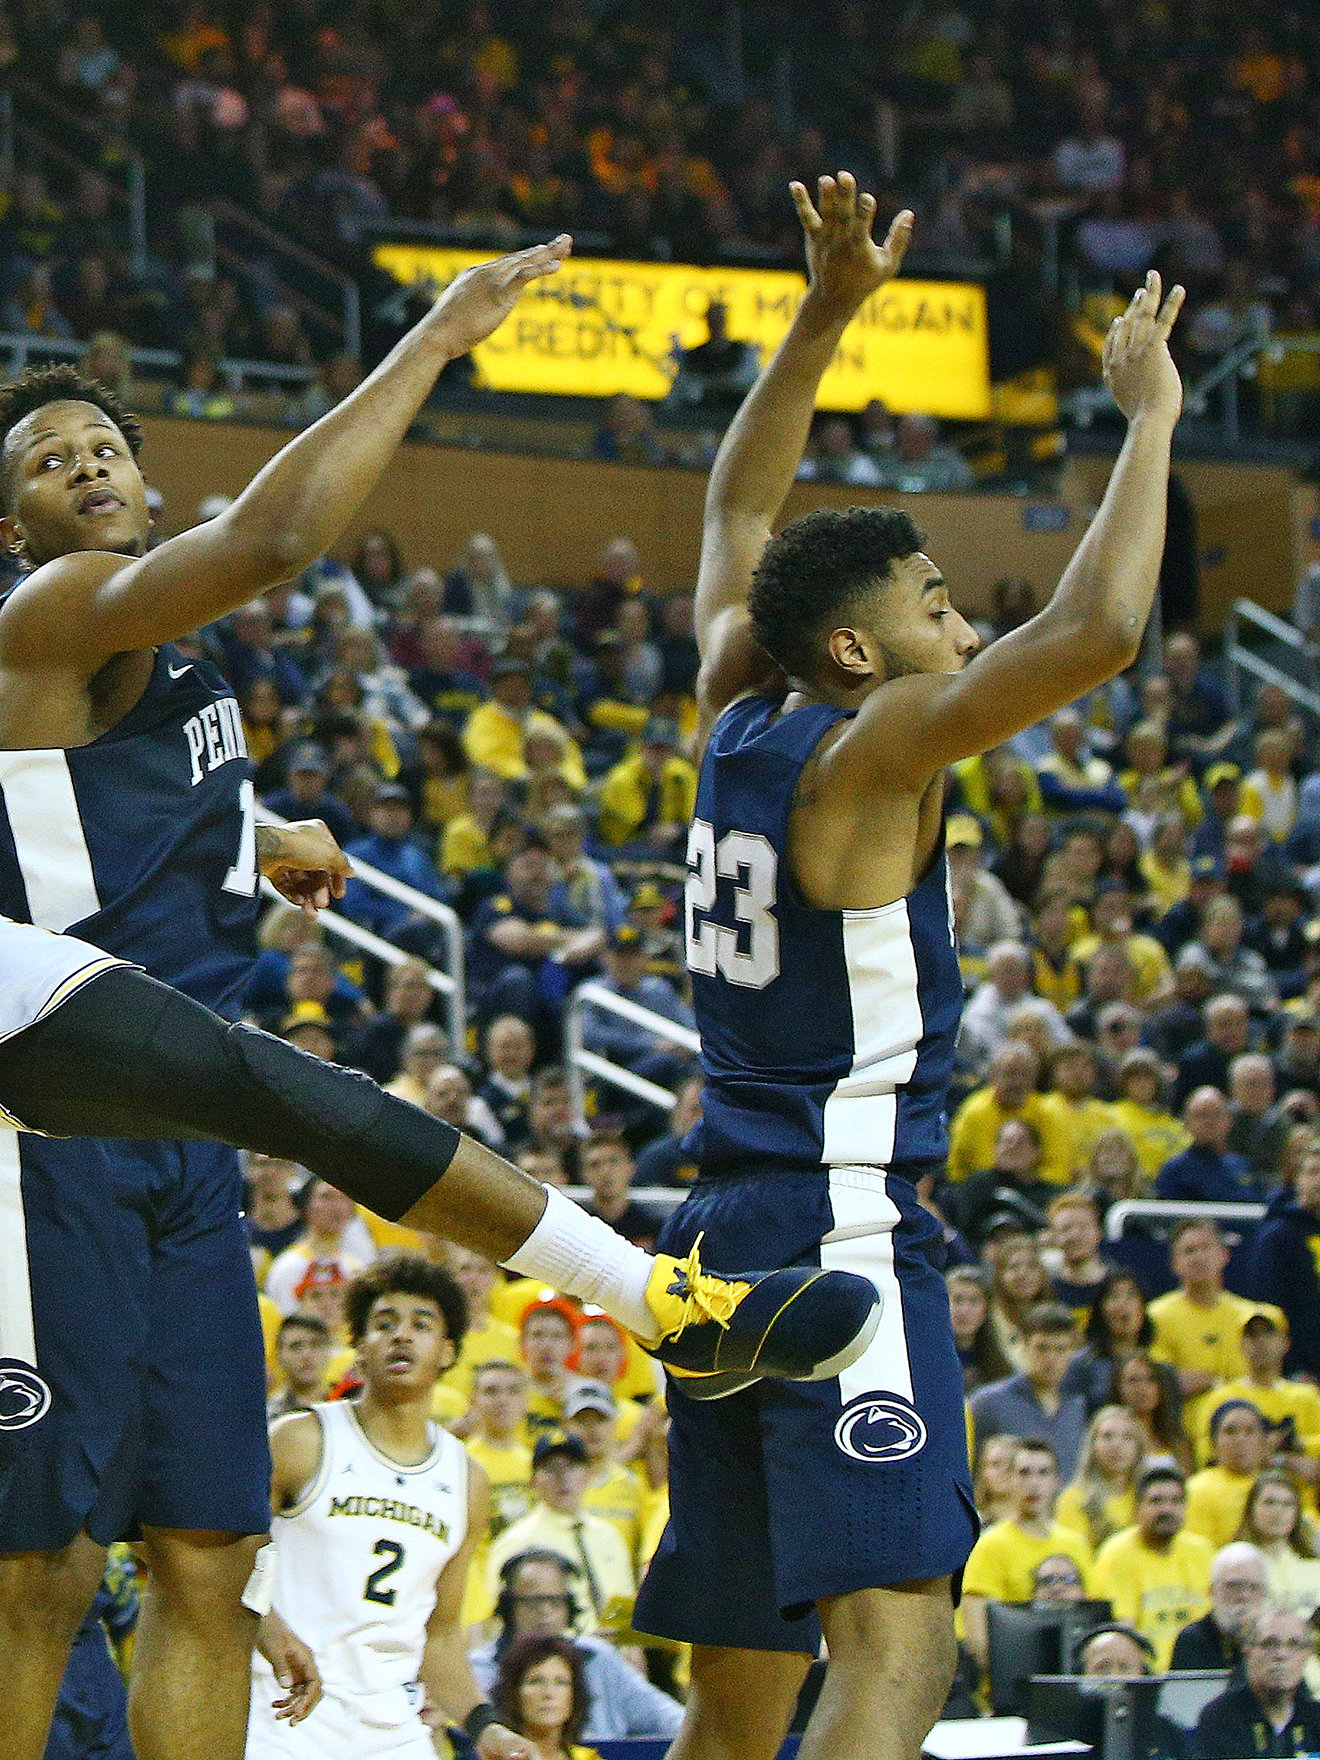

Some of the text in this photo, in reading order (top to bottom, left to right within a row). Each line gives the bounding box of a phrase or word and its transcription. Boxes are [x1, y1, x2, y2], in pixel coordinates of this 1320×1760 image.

[684, 817, 781, 990] 23
[327, 1495, 451, 1546] MICHIGAN
[362, 1538, 406, 1608] 2
